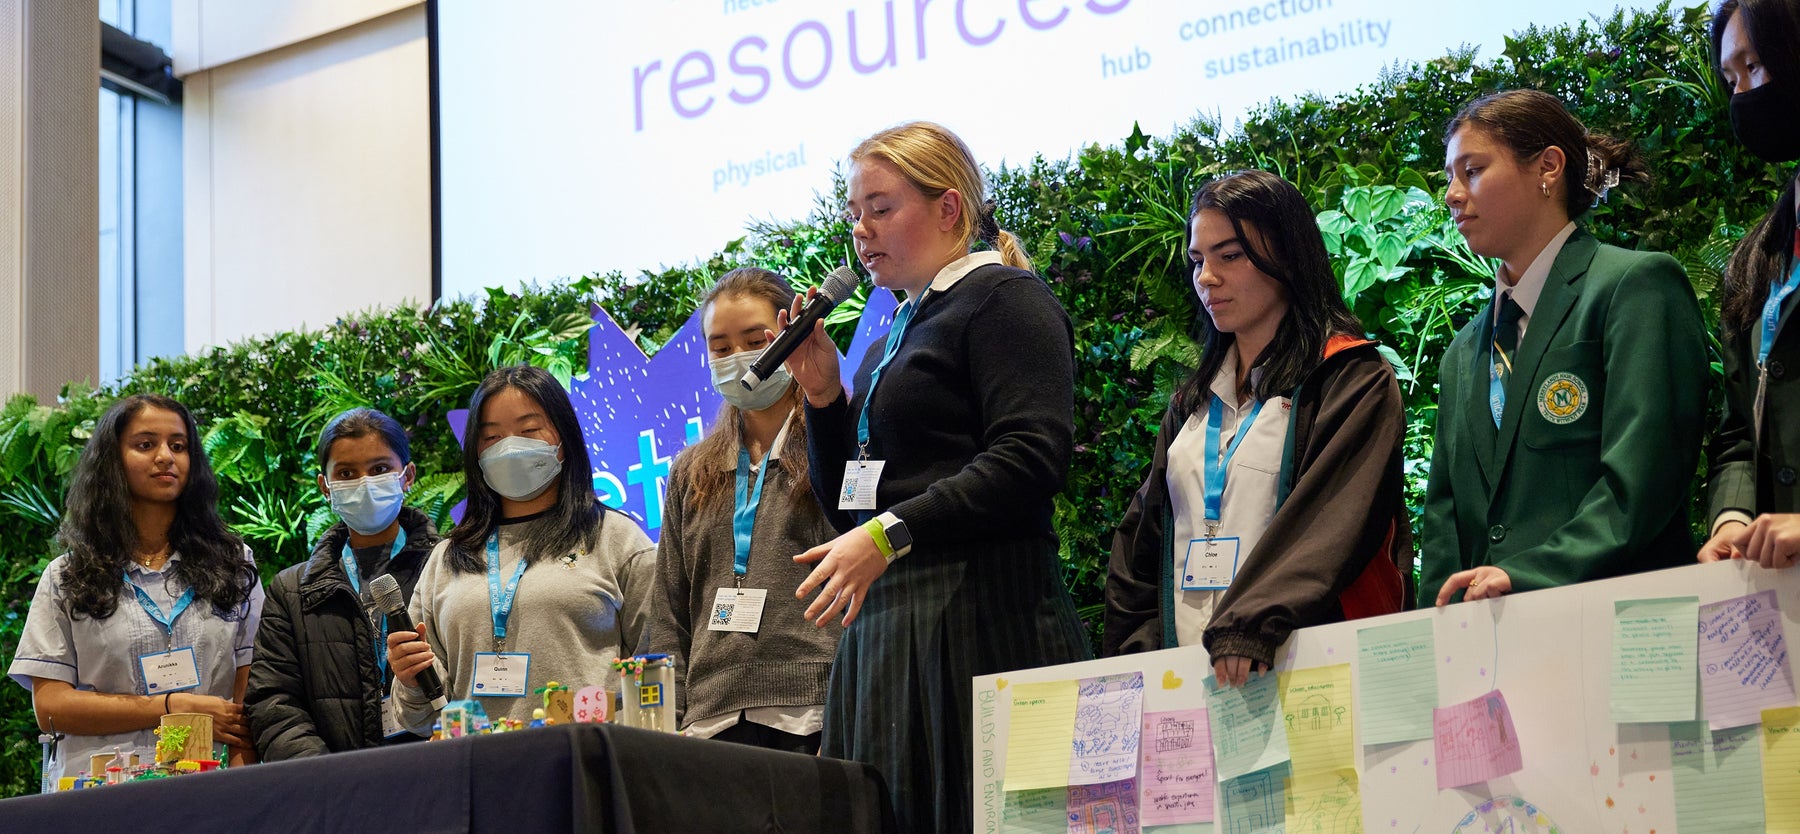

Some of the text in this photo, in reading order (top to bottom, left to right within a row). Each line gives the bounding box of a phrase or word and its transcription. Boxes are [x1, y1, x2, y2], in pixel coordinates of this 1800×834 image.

[632, 0, 1130, 132] resource
[1101, 46, 1152, 79] hub
[1204, 20, 1392, 80] sustainability
[711, 142, 807, 193] physical
[157, 661, 178, 670] Arunikka
[982, 749, 995, 778] AND
